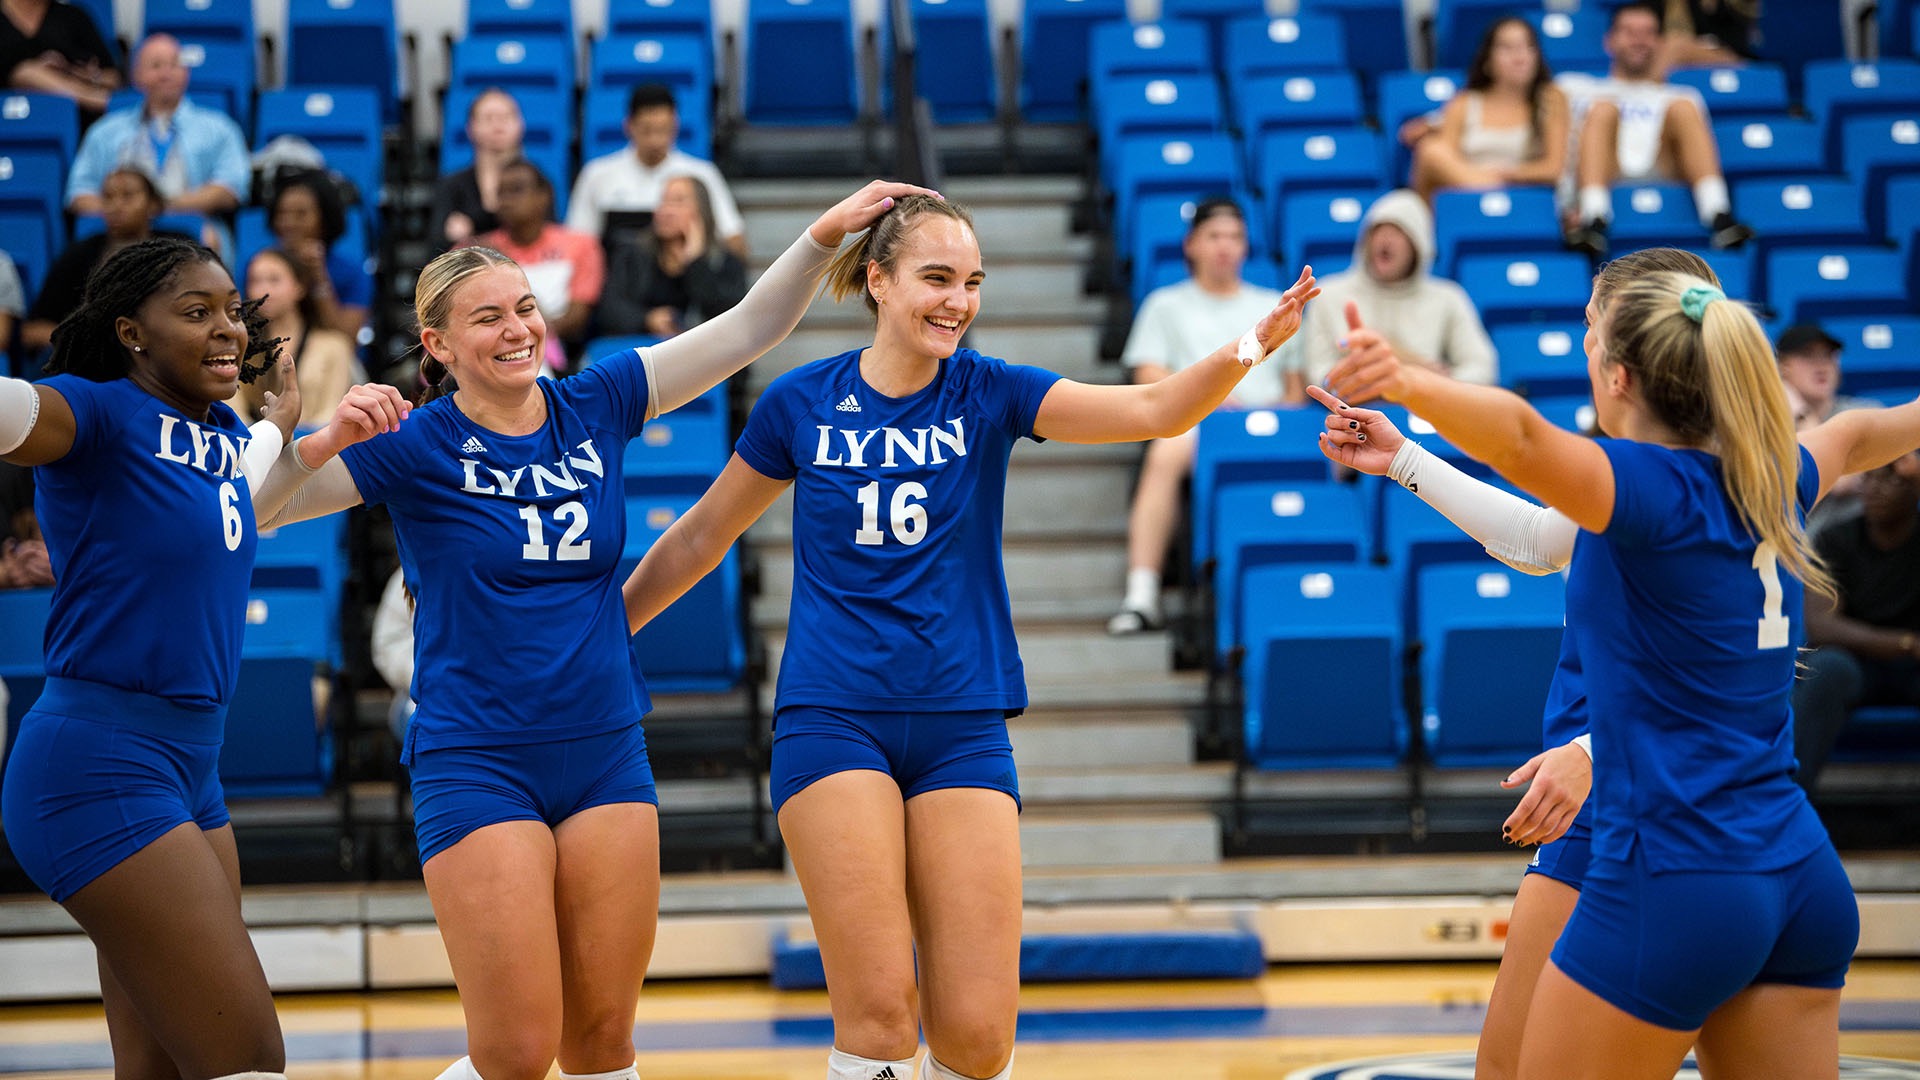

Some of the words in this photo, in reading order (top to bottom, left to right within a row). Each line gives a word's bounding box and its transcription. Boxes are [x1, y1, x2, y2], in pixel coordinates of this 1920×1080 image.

[835, 404, 862, 413] adidas
[155, 413, 251, 480] LYN
[459, 439, 604, 497] LYNN
[812, 416, 967, 468] LYNN
[219, 481, 243, 551] 6
[518, 501, 591, 561] 12
[855, 480, 928, 546] 16
[1752, 540, 1789, 650] 1
